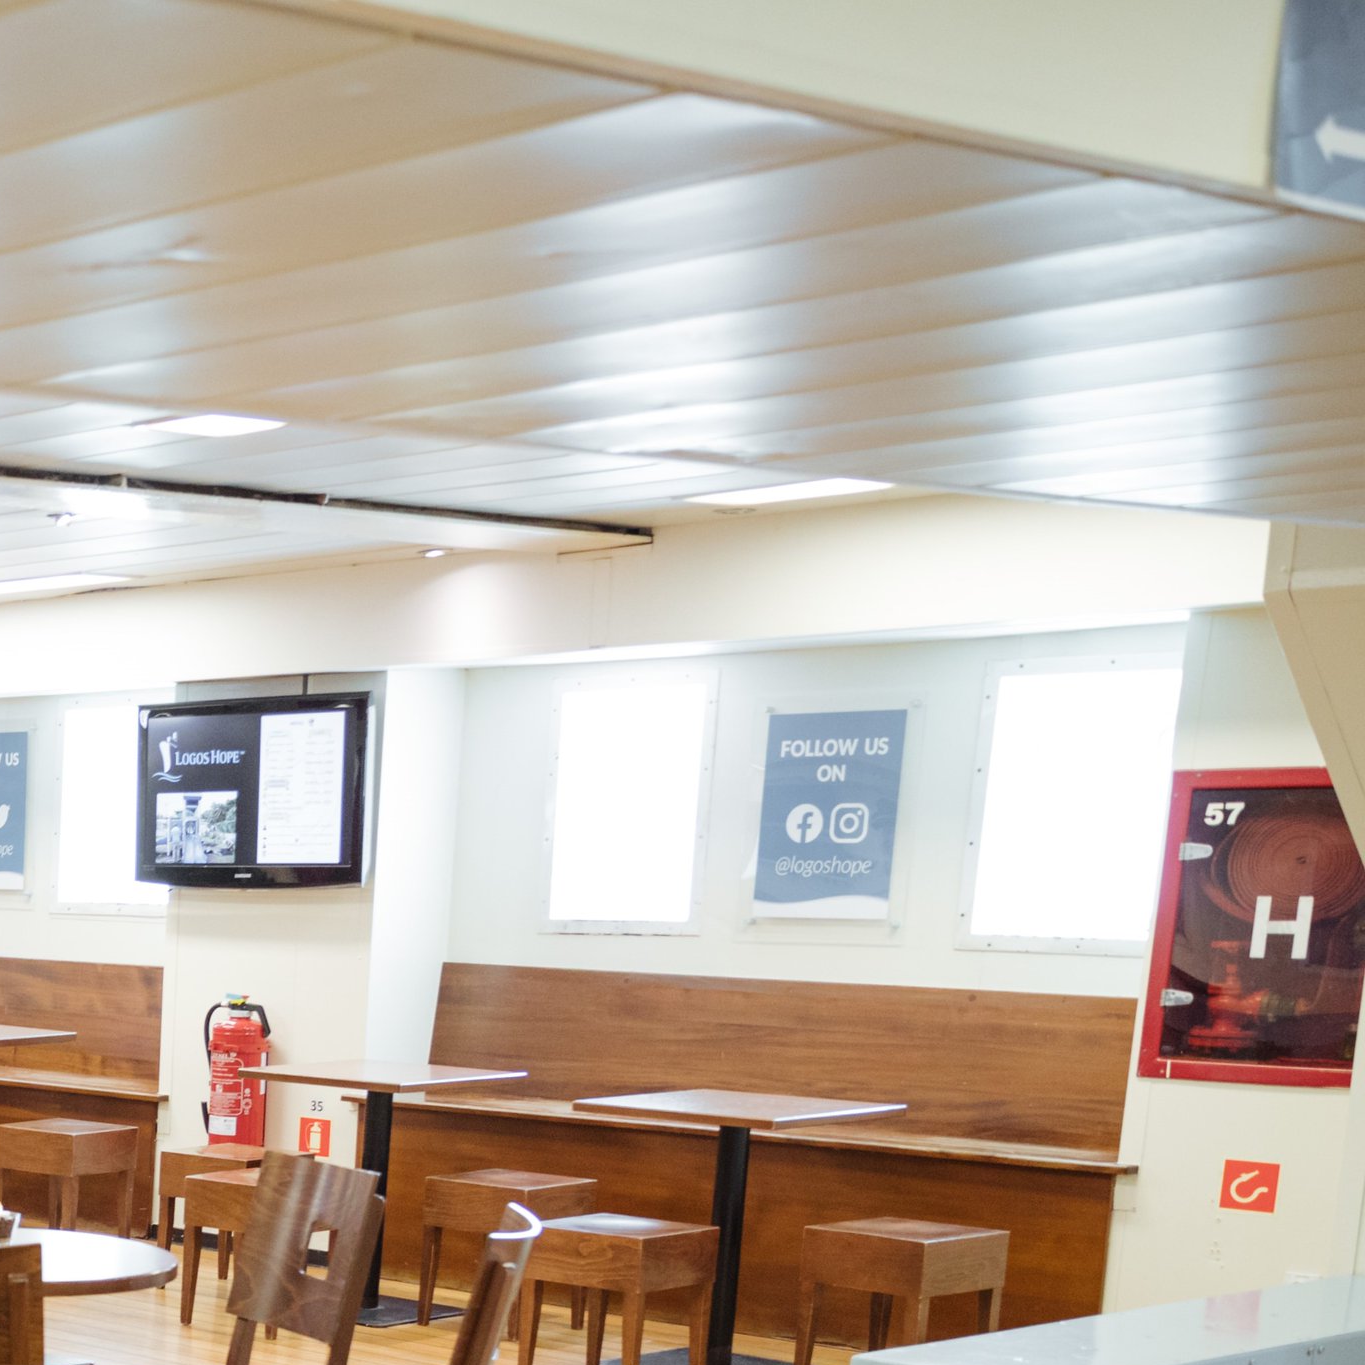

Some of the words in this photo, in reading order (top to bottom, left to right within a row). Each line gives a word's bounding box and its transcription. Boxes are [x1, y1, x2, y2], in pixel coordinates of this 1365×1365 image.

[780, 738, 859, 758] FOLLOW
[864, 737, 890, 755] US
[5, 752, 20, 766] US
[174, 750, 210, 766] LOGOS
[210, 749, 241, 764] HOPE
[816, 764, 847, 782] ON
[1203, 801, 1246, 827] 57
[775, 855, 873, 878] @logoshope
[1248, 895, 1315, 960] H
[310, 1100, 324, 1112] 35
